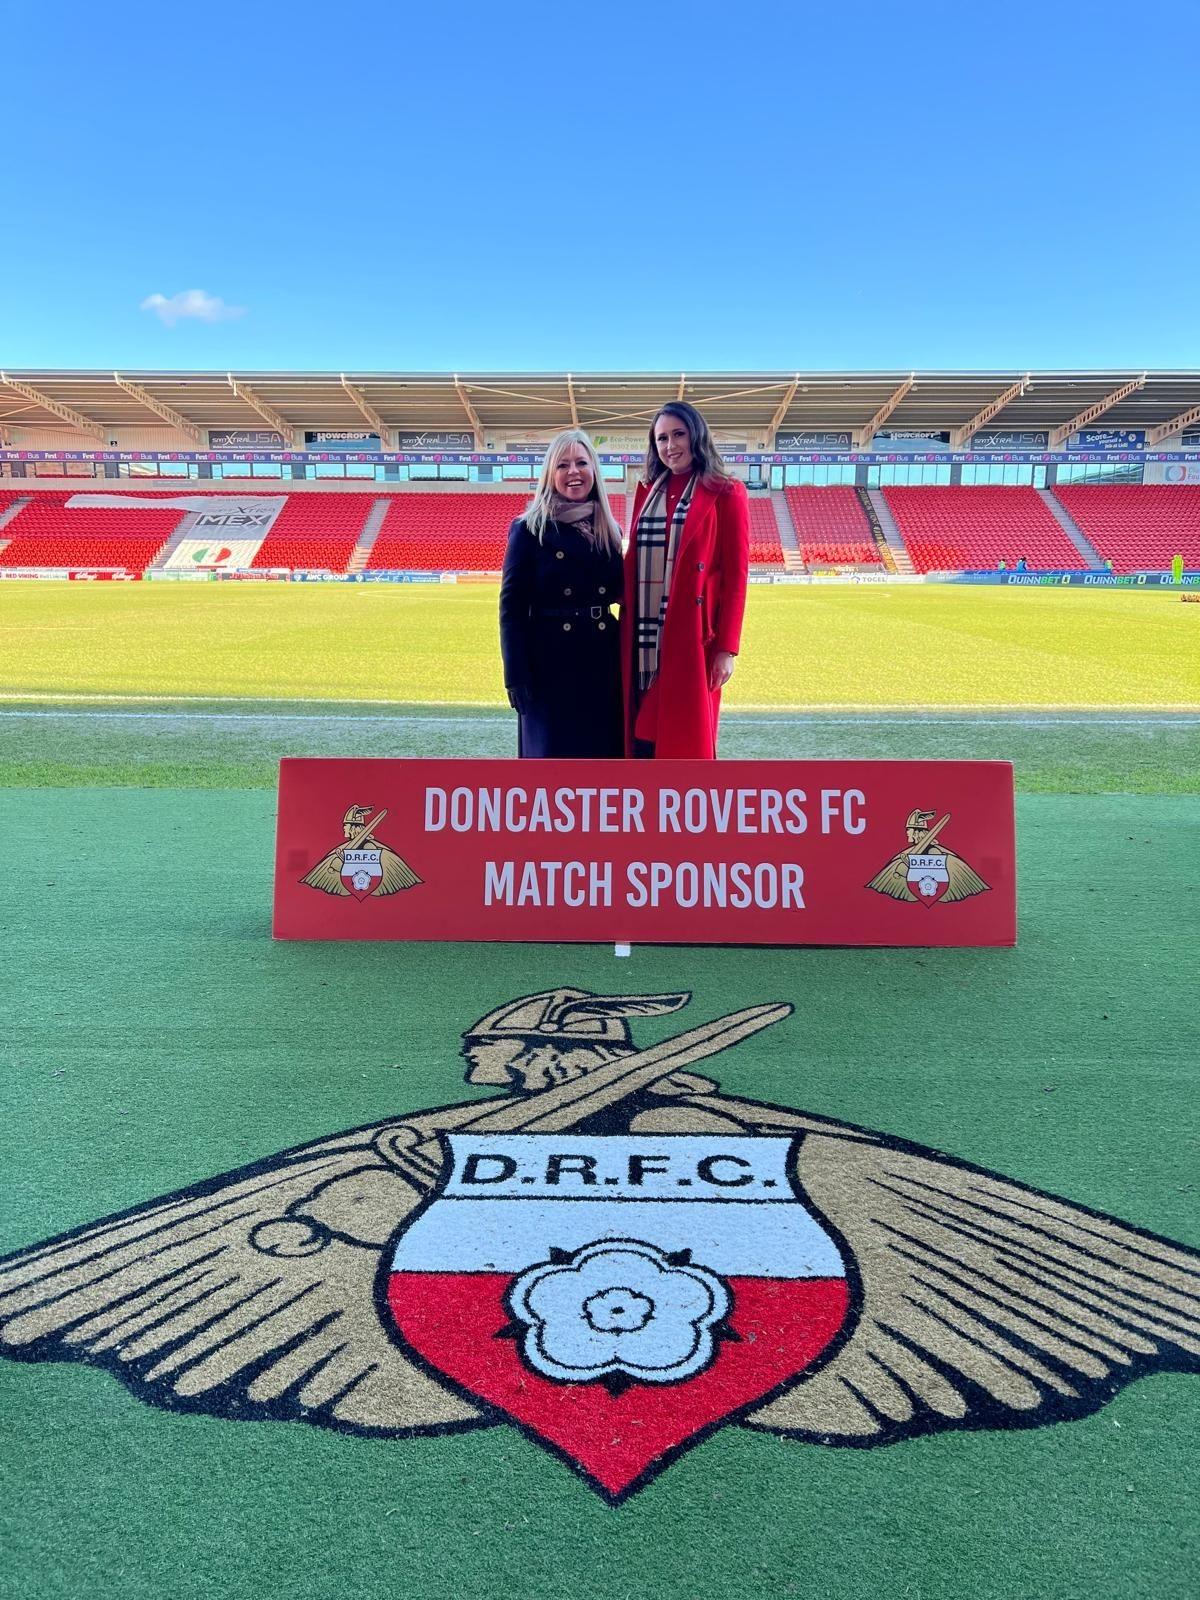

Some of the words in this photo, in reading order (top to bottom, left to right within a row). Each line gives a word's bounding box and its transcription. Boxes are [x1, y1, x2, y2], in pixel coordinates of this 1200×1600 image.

[198, 514, 271, 526] MEX
[424, 786, 645, 833] DONCASTER
[658, 788, 808, 834] ROVERS
[821, 789, 866, 835] FC
[345, 853, 380, 862] D.R.F.C.
[910, 858, 944, 868] D.R.F.C.
[484, 861, 612, 907] MATCH
[626, 862, 806, 909] SPONSOR
[460, 1153, 778, 1187] D.R.F.C.
